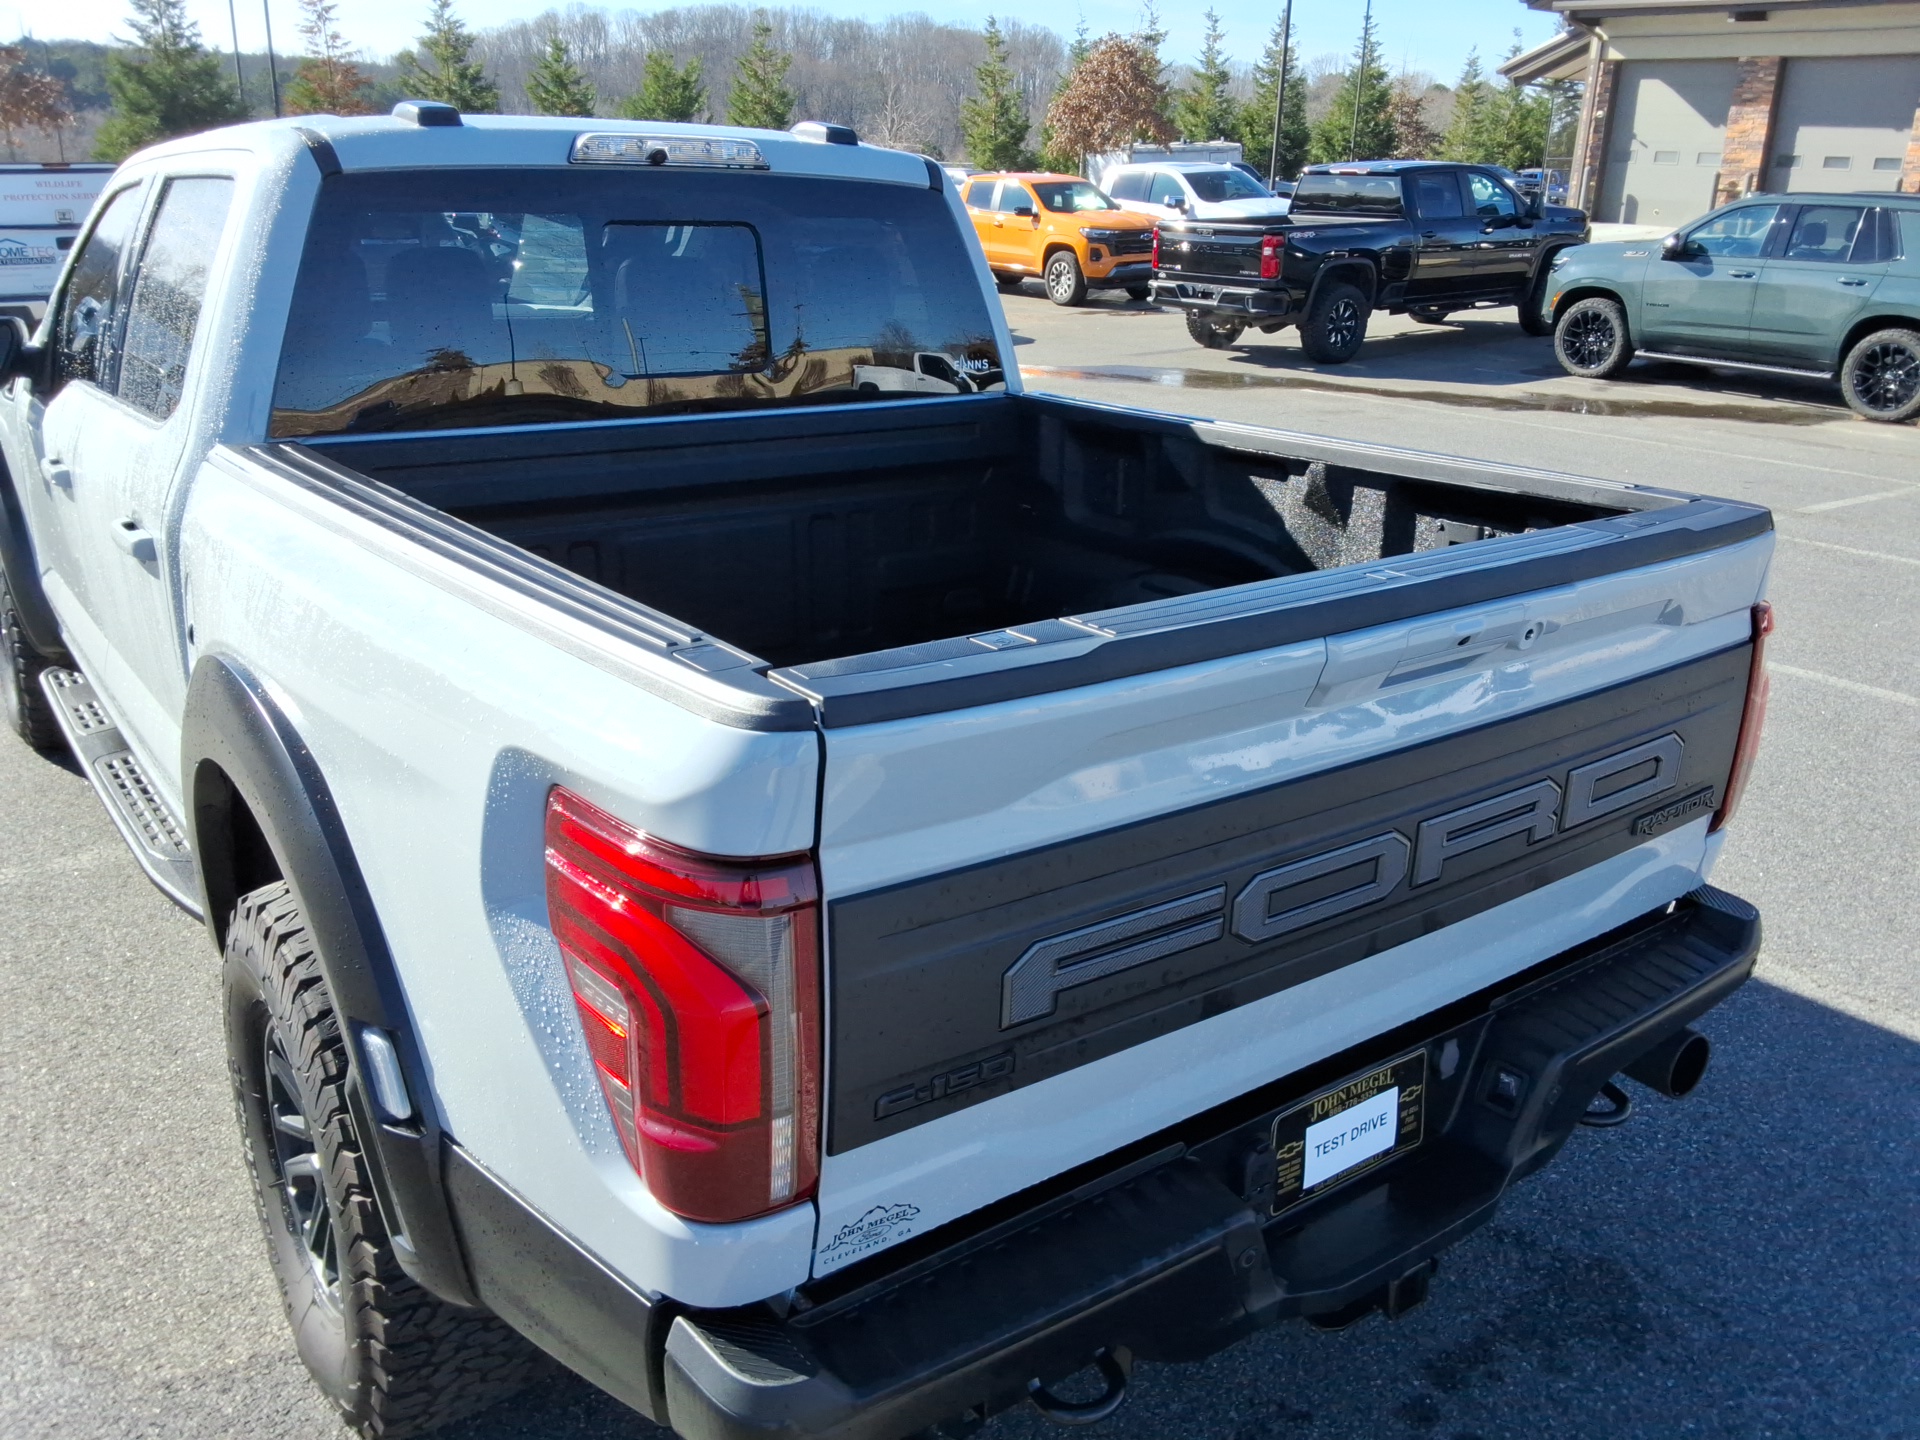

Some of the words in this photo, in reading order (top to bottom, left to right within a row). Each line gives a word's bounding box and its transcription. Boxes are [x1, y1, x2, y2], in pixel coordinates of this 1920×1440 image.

[3, 192, 70, 201] PROTECTION
[71, 192, 99, 200] SERVI
[34, 180, 83, 188] WILDLIFE
[0, 246, 55, 258] OMETEC
[1631, 785, 1715, 836] RAPTOR
[999, 731, 1686, 1031] FORD
[874, 1050, 1016, 1121] F-150
[1311, 1088, 1347, 1122] JOHN
[1349, 1068, 1395, 1098] MEGEL
[1314, 1132, 1348, 1158] TEST
[1350, 1111, 1389, 1142] DRIVE
[823, 1236, 892, 1265] CLEVELAND,
[897, 1227, 912, 1237] GA
[831, 1224, 864, 1247] JOHN
[867, 1209, 909, 1230] MEGEL
[857, 1227, 885, 1243] Ford
